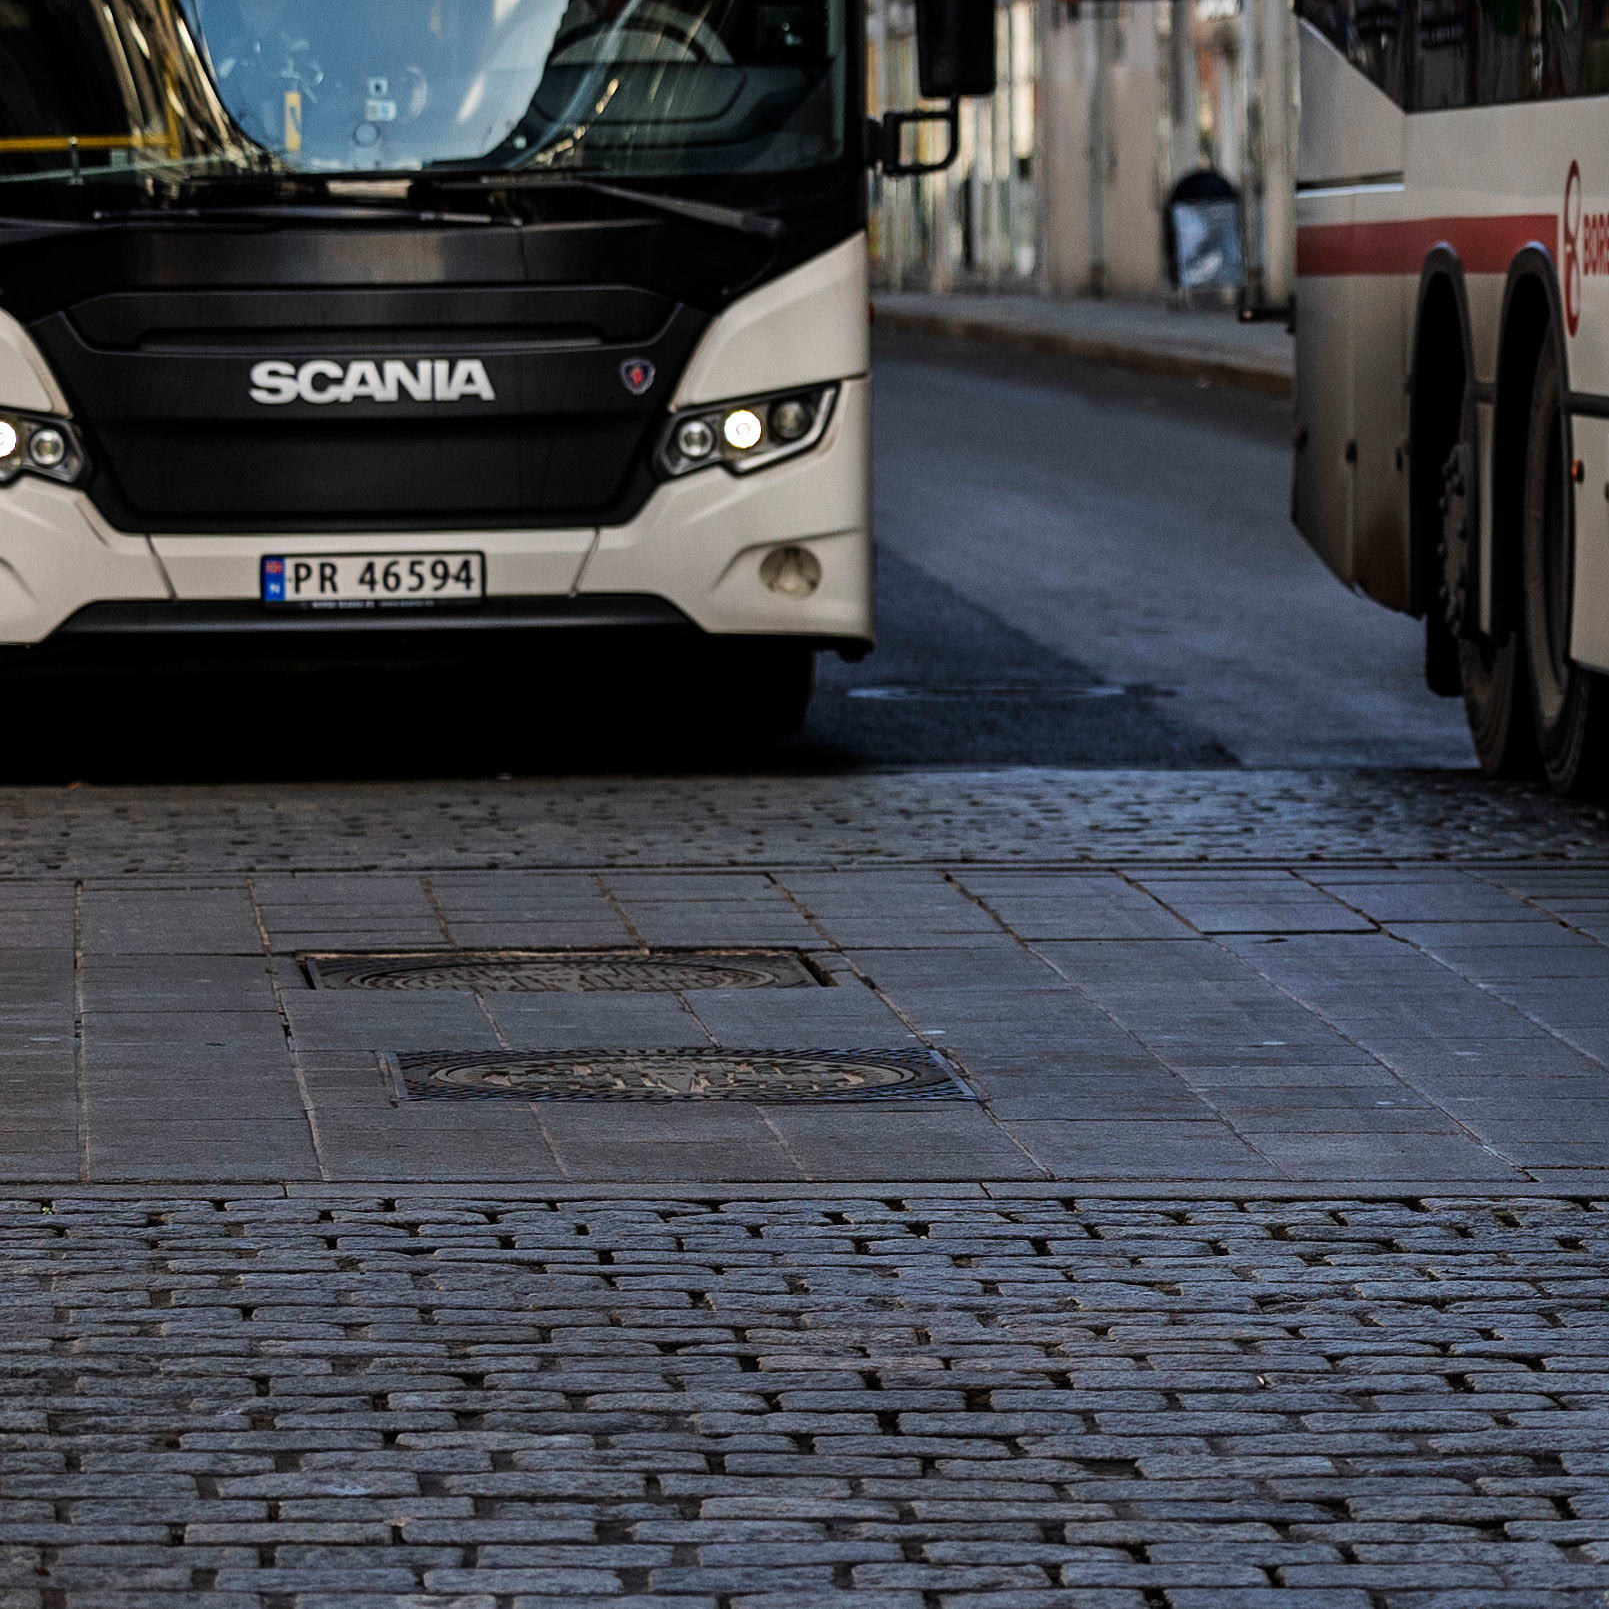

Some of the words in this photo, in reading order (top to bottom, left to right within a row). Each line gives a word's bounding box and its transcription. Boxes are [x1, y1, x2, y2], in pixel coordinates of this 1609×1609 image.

[249, 359, 496, 405] SCANIA
[294, 562, 337, 594] PR
[358, 559, 474, 593] 46594
